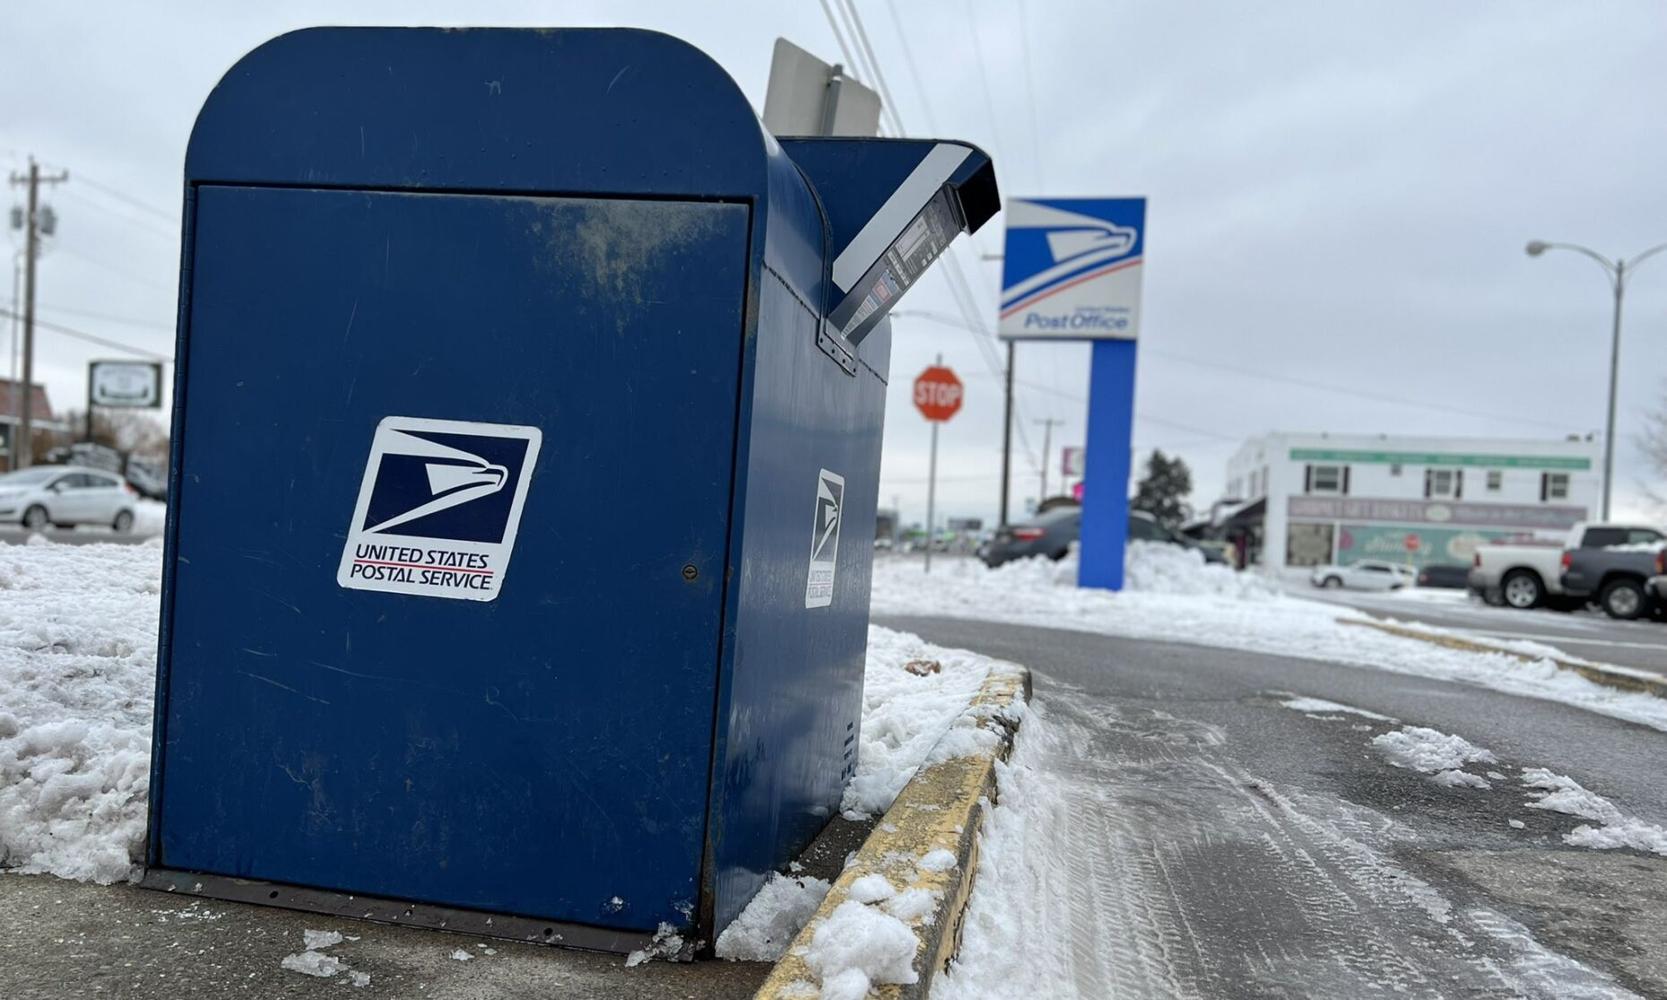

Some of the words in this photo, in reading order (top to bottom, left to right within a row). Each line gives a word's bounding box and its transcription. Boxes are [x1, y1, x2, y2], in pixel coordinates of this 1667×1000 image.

[1025, 312, 1066, 328] Post
[1070, 313, 1128, 330] Office
[915, 381, 961, 406] STOP
[356, 544, 423, 562] UNITED
[425, 550, 489, 569] STATES
[350, 564, 415, 583] POSTAL
[419, 570, 493, 590] SERVICE
